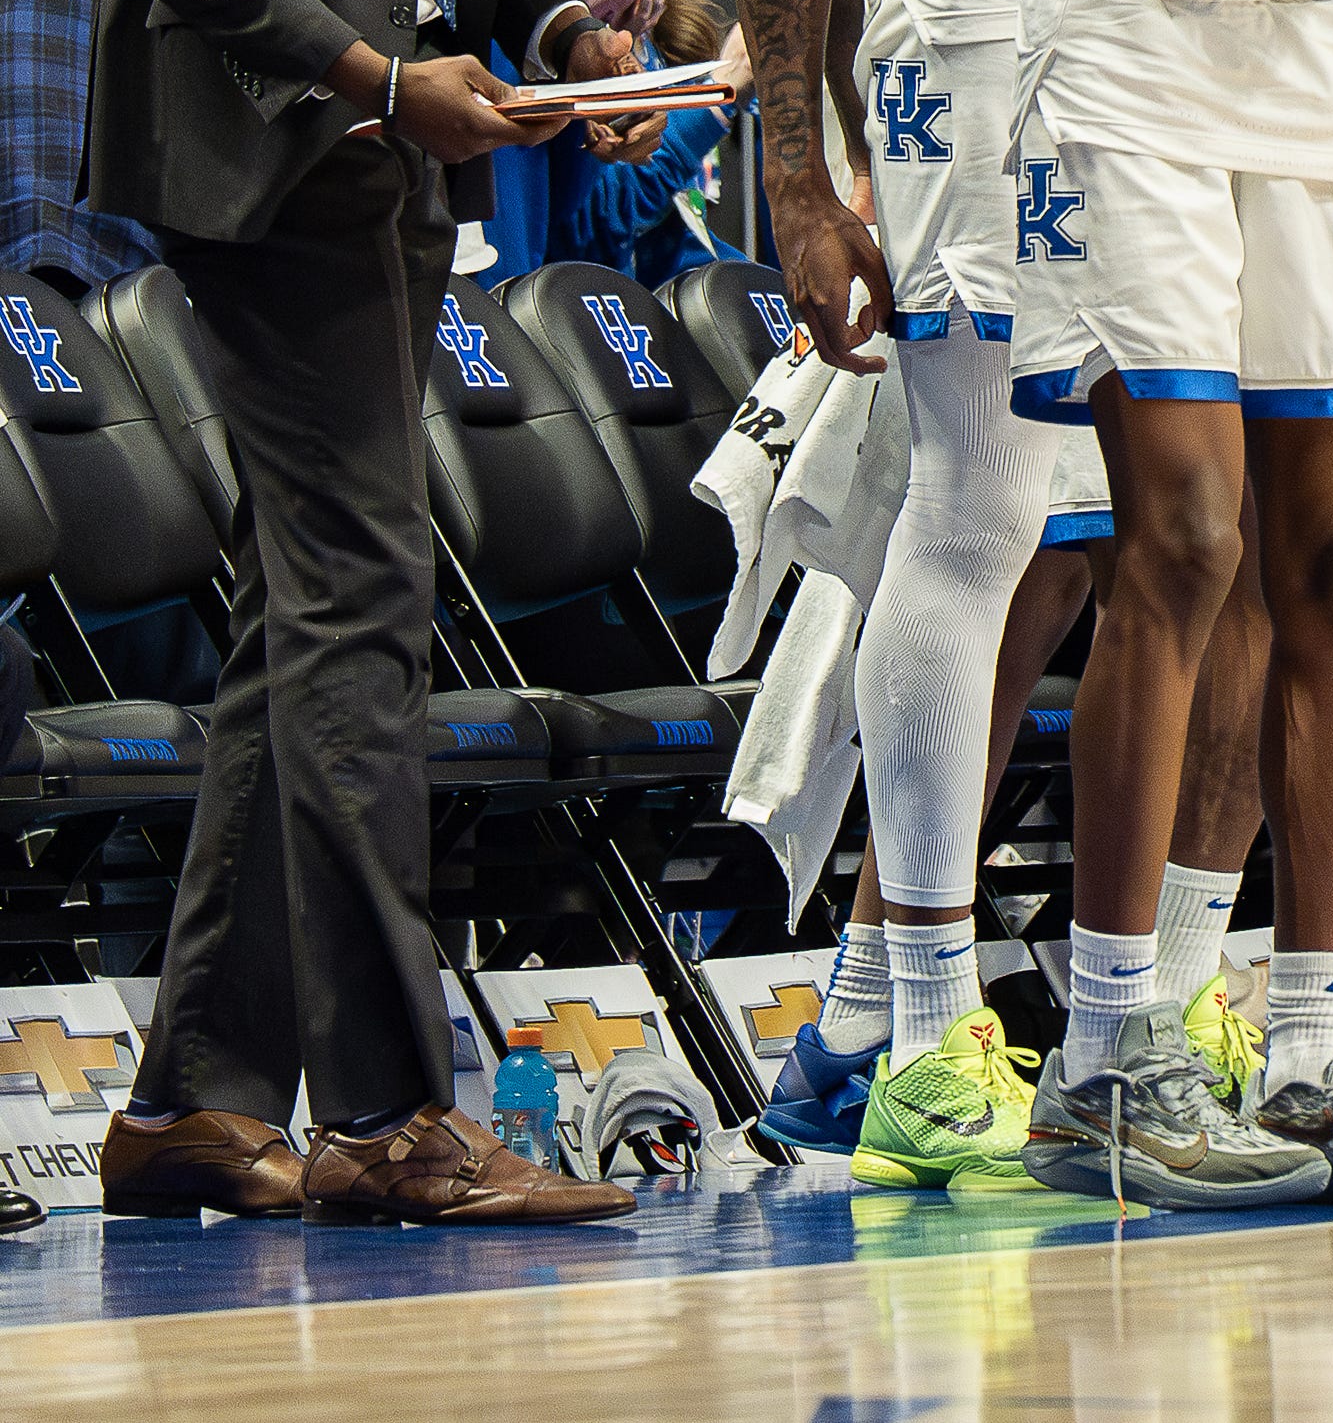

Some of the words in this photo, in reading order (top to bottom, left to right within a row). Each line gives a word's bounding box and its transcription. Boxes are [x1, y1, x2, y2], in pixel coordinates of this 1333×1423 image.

[869, 58, 953, 162] UK
[0, 295, 83, 393] UK
[581, 295, 674, 388] UK
[748, 293, 796, 349] U
[17, 1141, 104, 1178] CHEV
